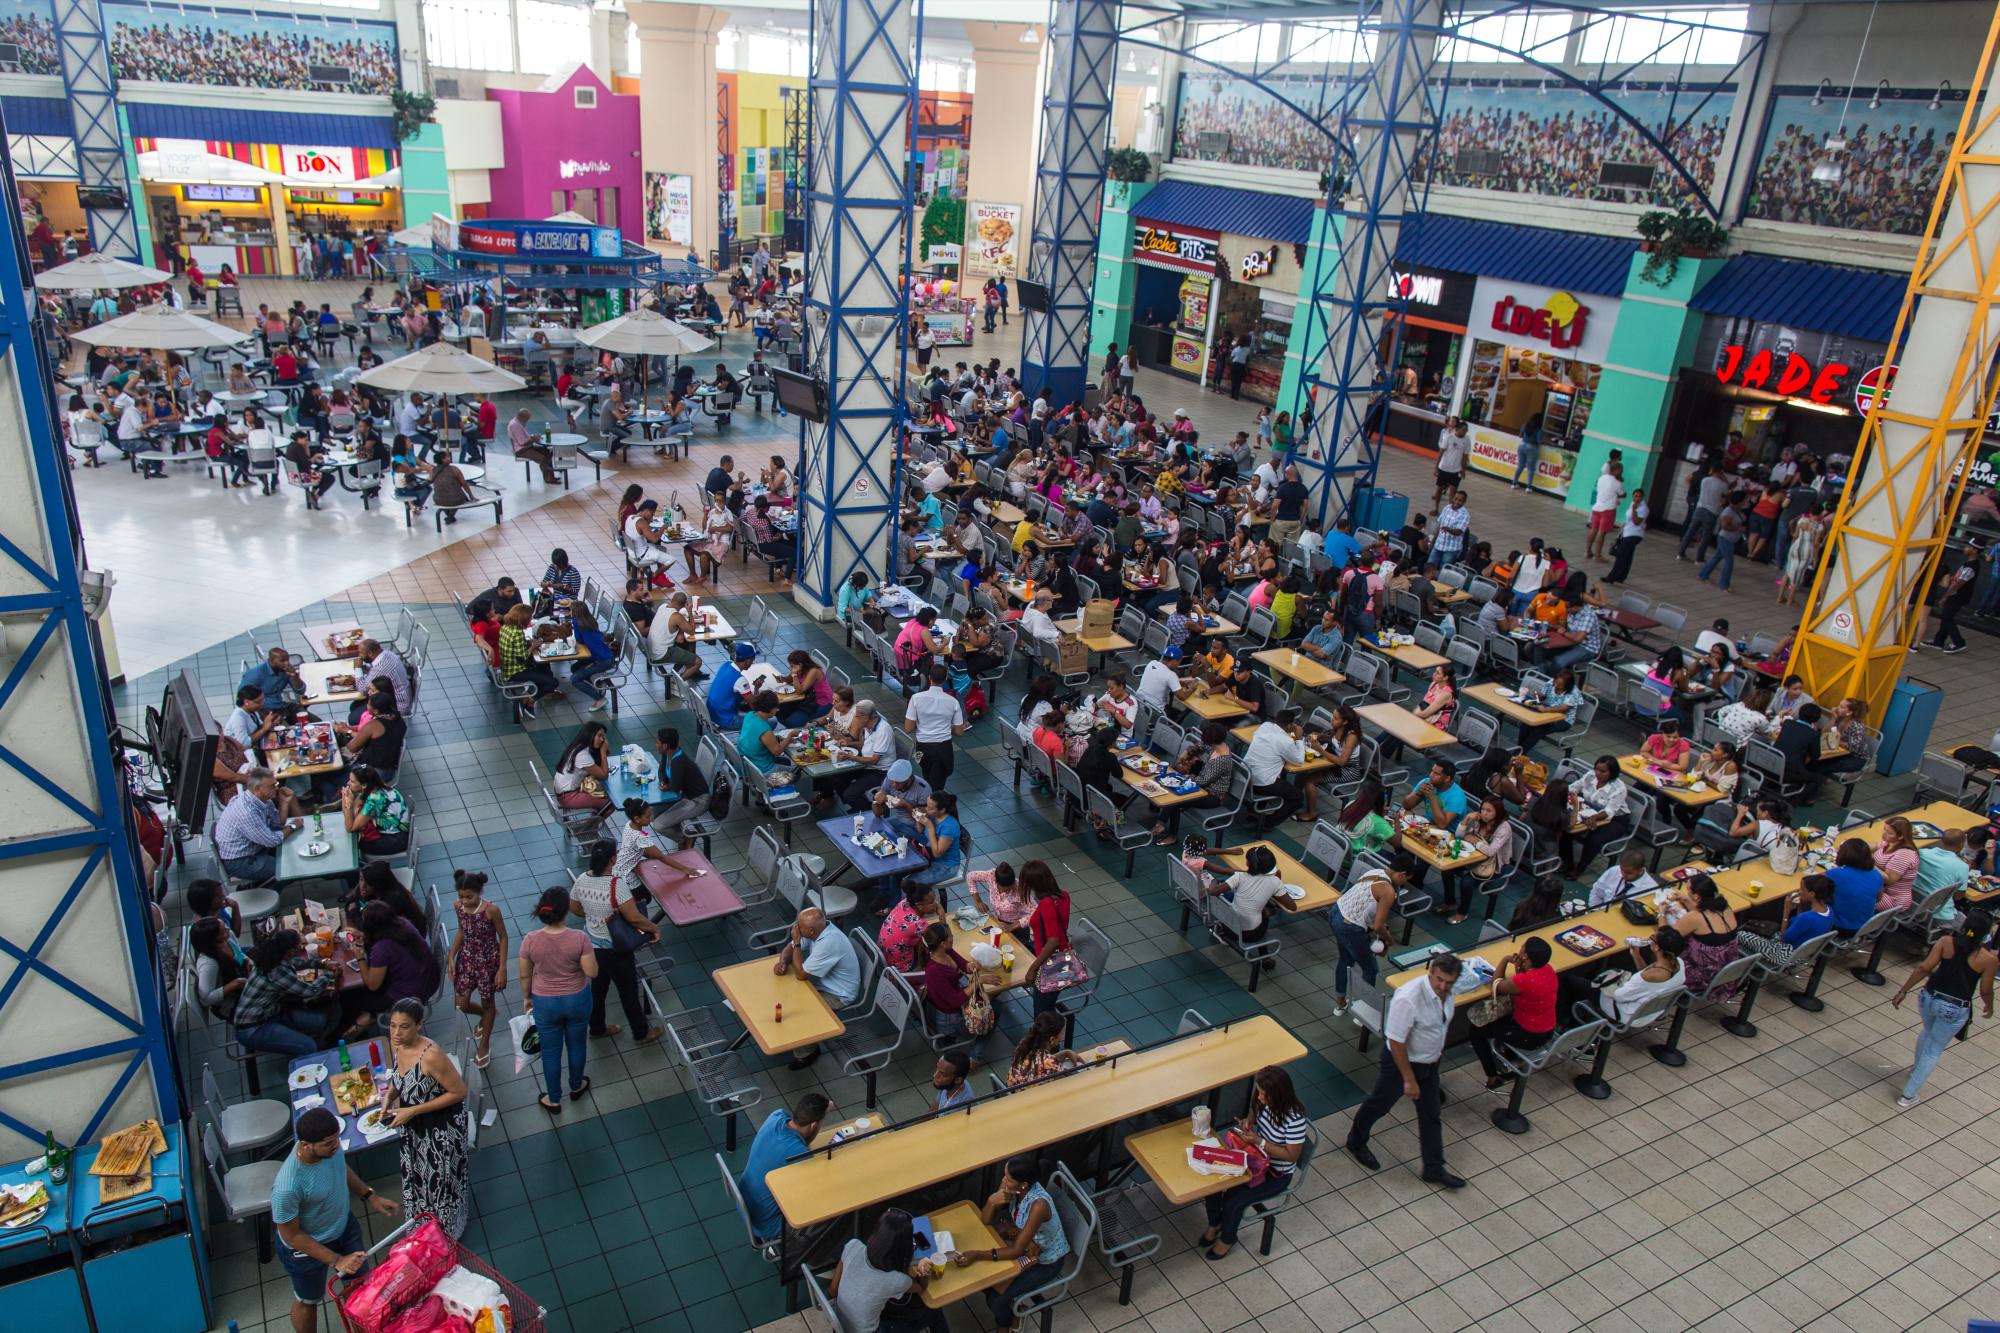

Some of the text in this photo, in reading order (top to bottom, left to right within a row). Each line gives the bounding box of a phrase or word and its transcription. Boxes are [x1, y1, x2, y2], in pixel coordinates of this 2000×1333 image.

[296, 154, 342, 174] BON
[978, 209, 1015, 220] BUCKET
[981, 240, 1009, 259] KFC
[1142, 228, 1177, 253] Cacha
[1717, 345, 1849, 403] JADE
[1473, 442, 1521, 465] SANDWICHE
